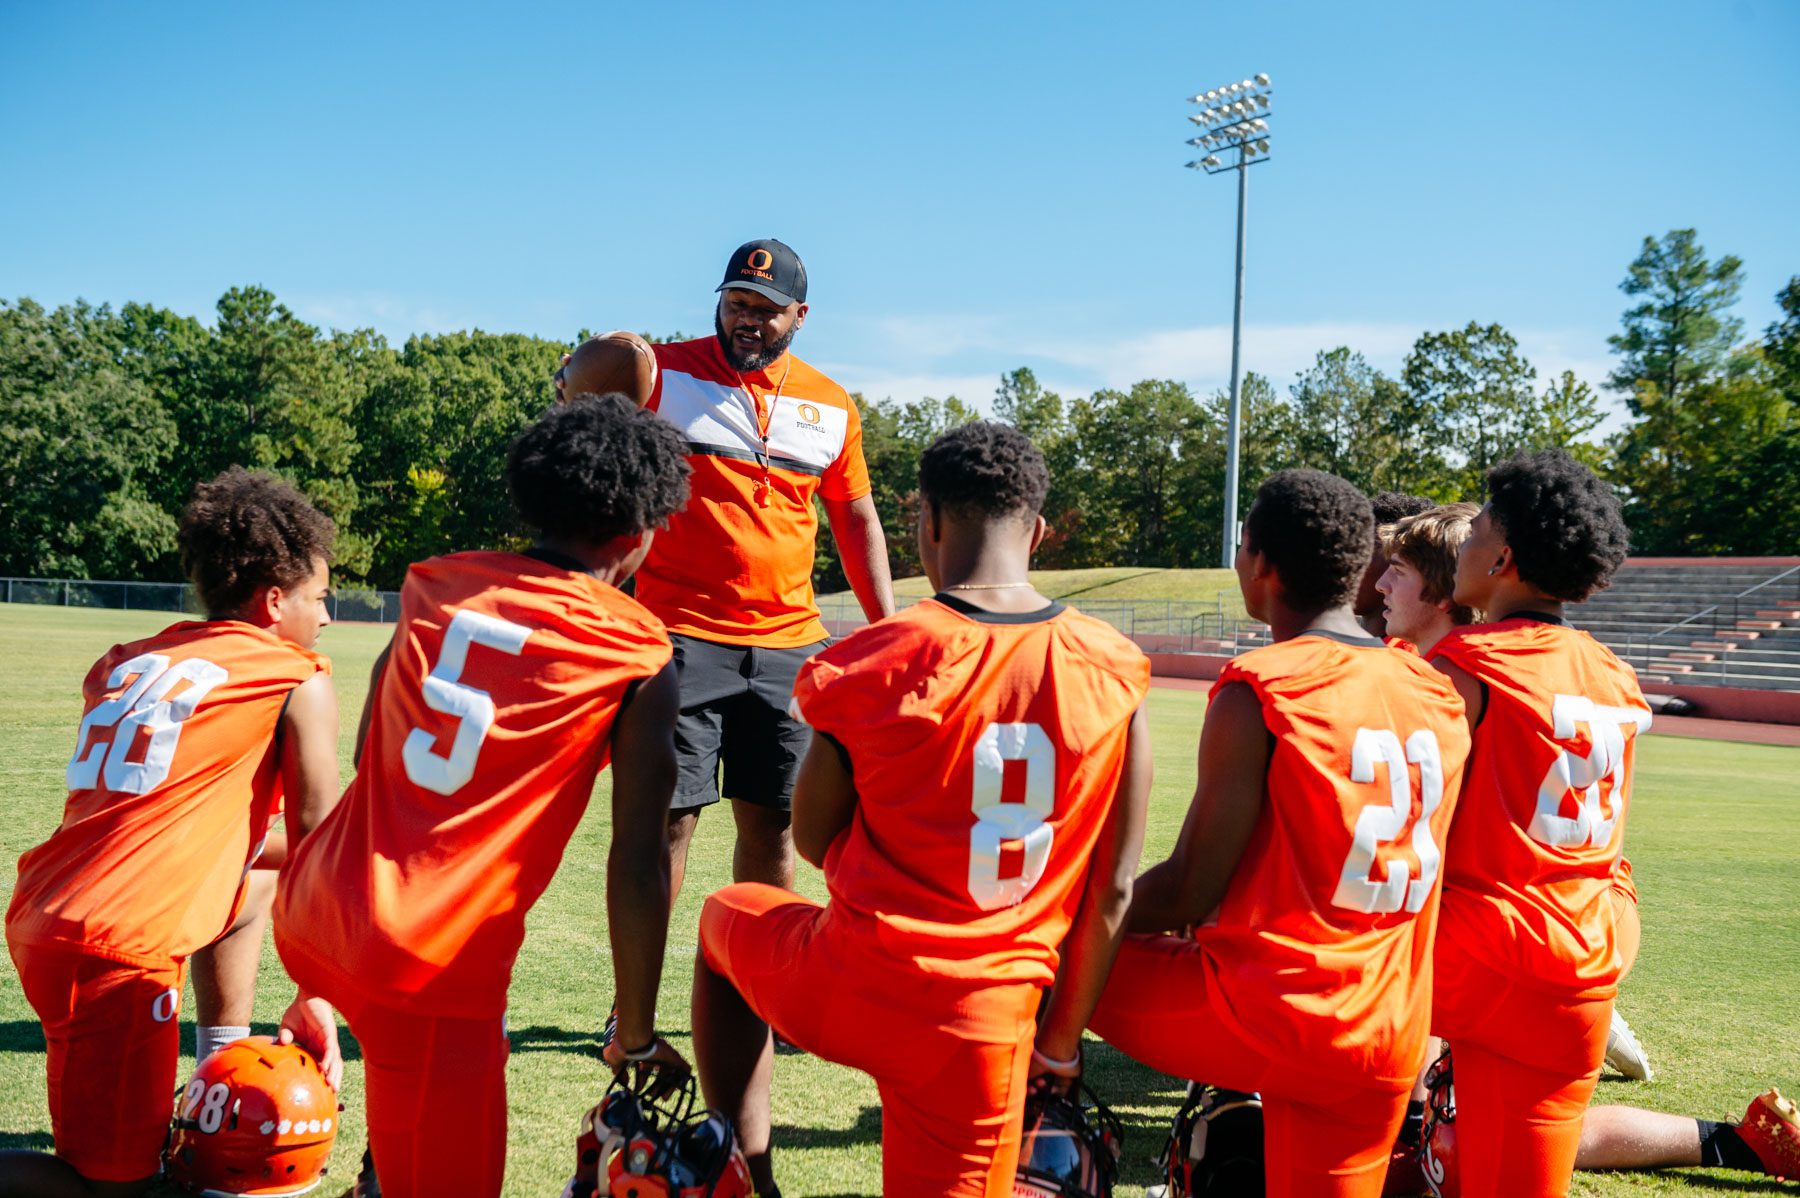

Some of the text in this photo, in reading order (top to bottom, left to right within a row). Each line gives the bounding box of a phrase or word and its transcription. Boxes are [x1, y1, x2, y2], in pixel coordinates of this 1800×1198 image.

[741, 269, 774, 280] FOOTBALL
[65, 653, 228, 795] 28
[402, 609, 534, 795] 5
[968, 722, 1056, 911] 8
[181, 1078, 230, 1133] 28
